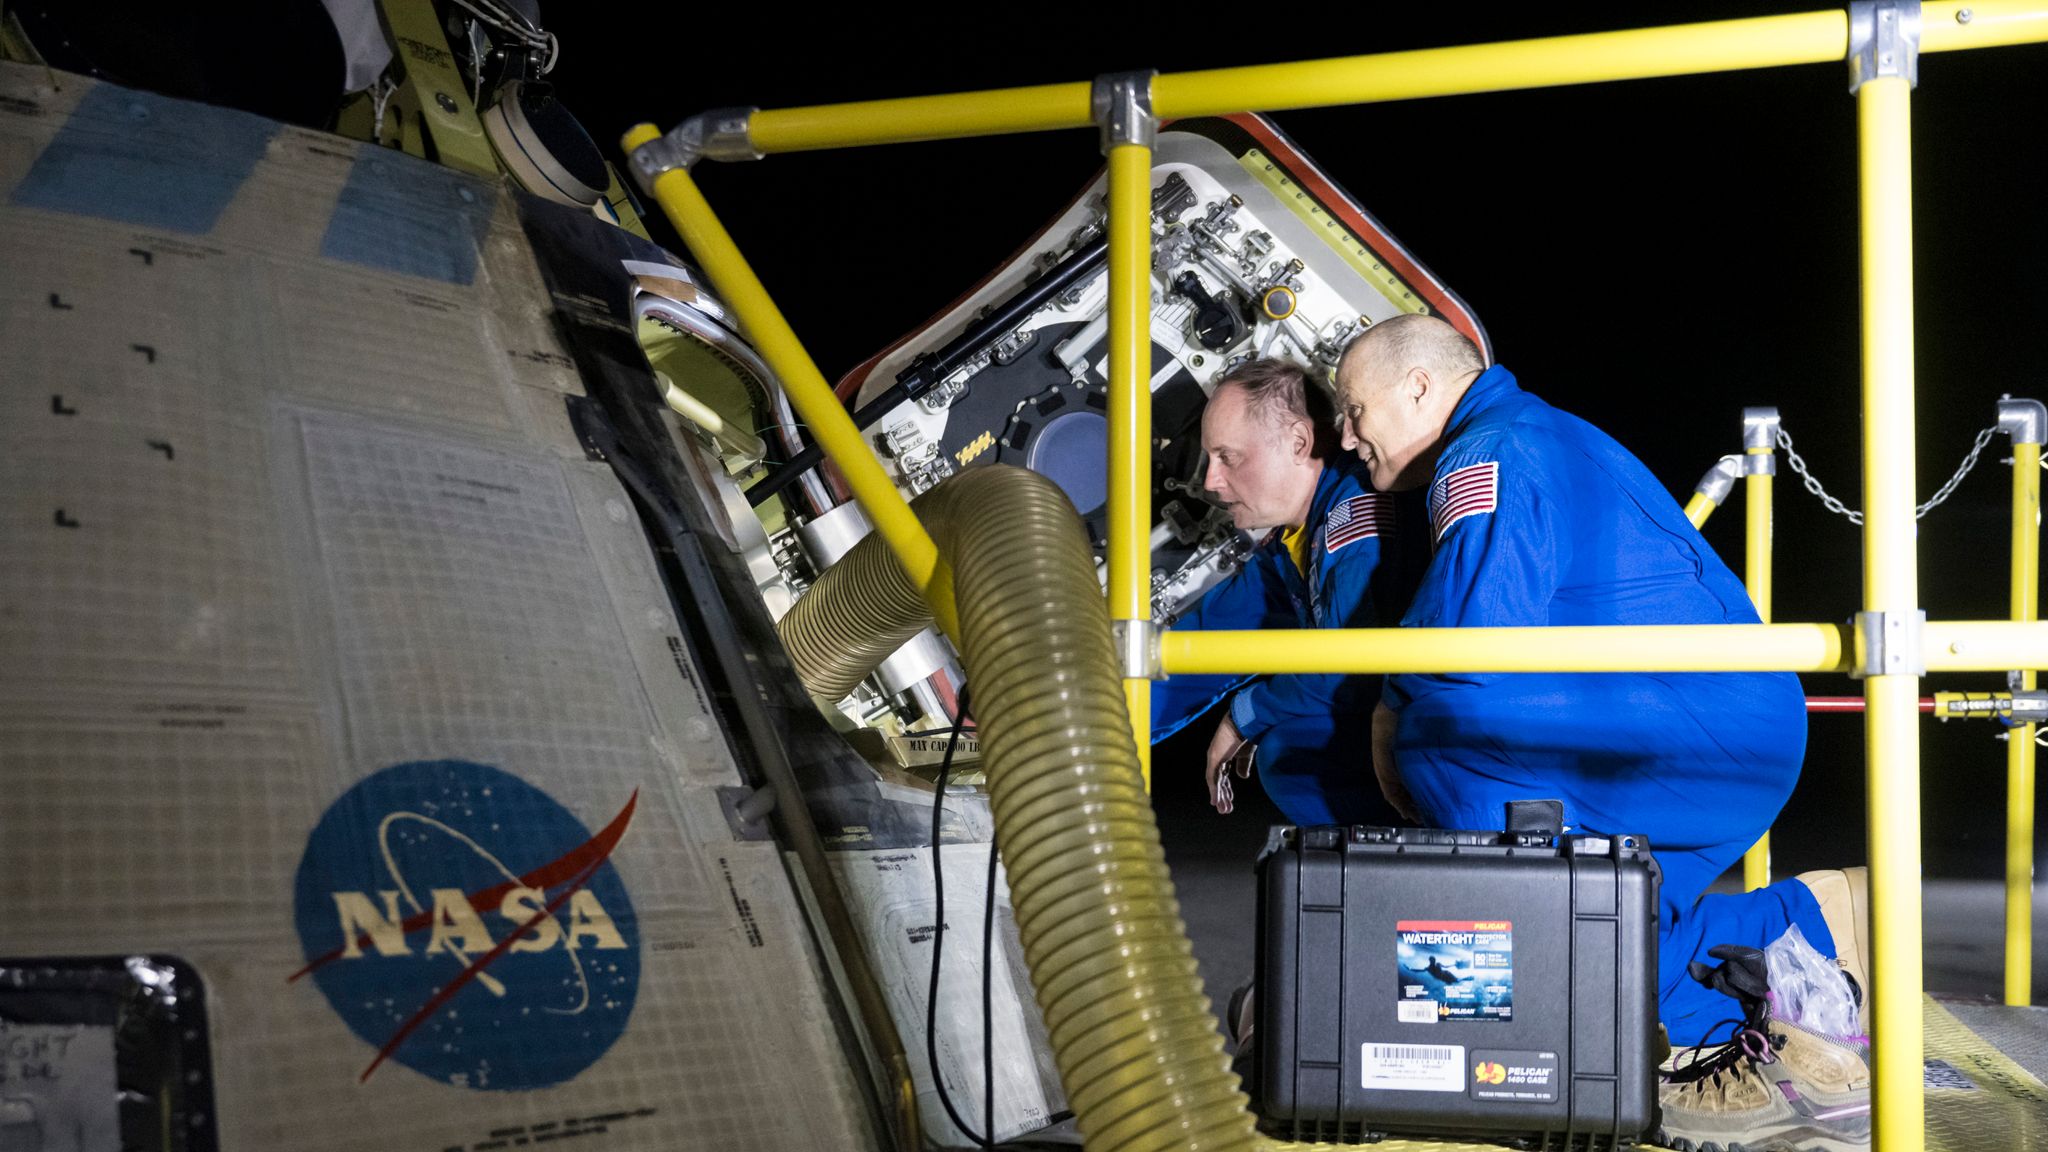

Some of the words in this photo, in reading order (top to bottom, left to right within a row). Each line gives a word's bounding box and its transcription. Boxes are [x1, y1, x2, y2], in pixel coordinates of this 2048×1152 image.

[910, 741, 927, 751] MAX
[931, 741, 947, 751] CAP
[331, 887, 628, 958] NASA
[1403, 933, 1474, 945] WATERTIGHT
[1508, 1067, 1549, 1076] PELICAN
